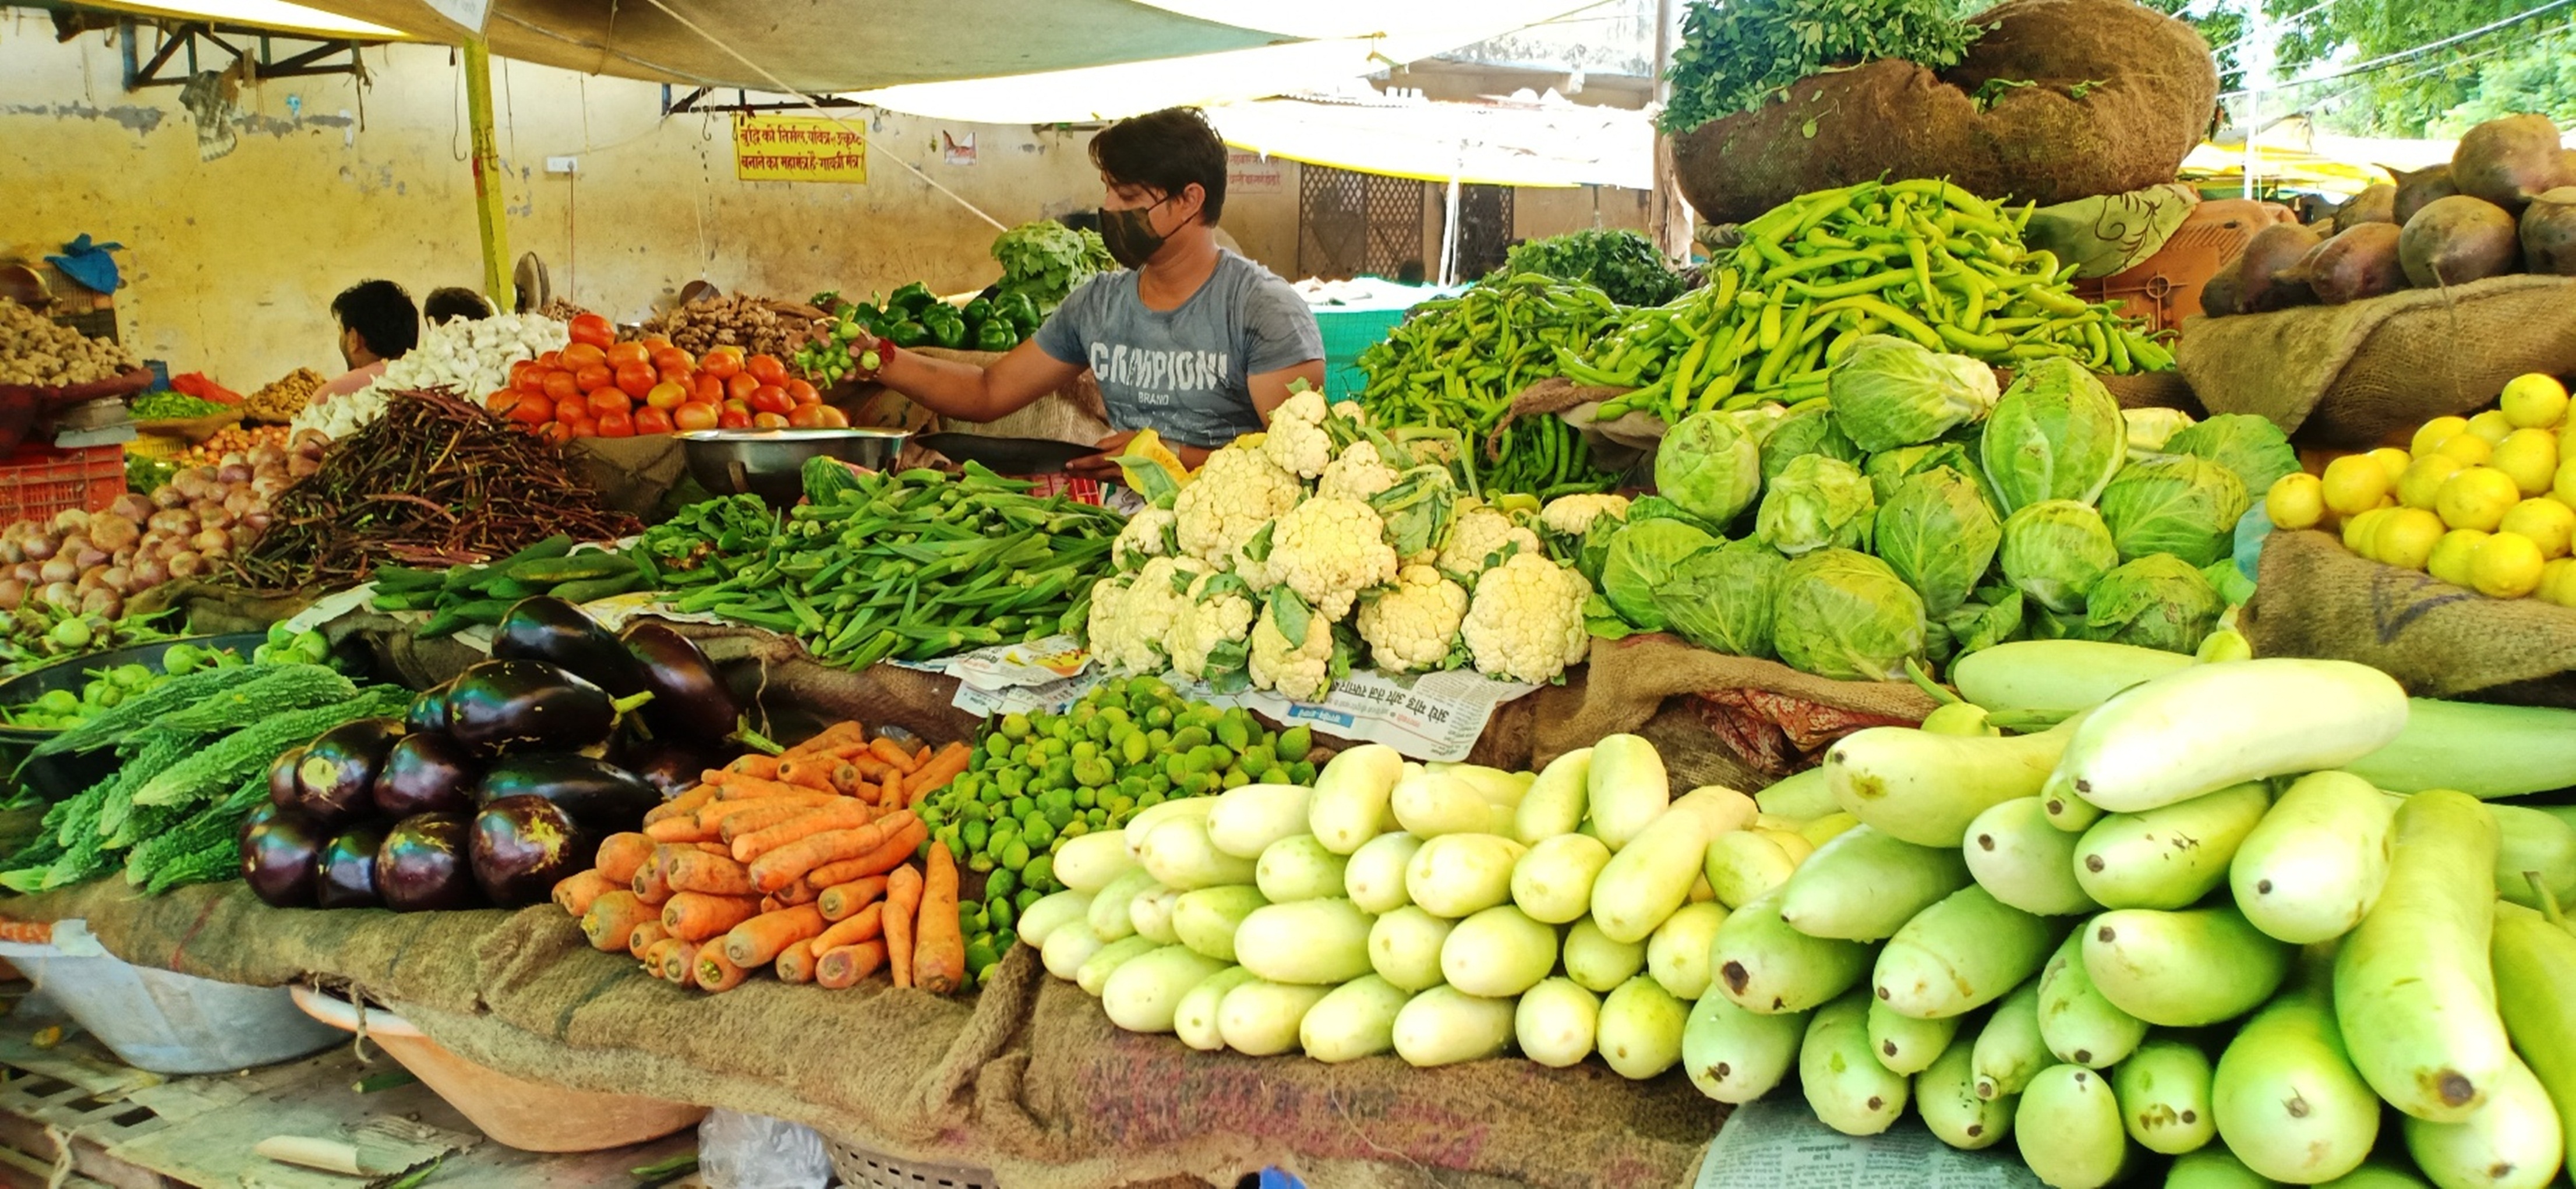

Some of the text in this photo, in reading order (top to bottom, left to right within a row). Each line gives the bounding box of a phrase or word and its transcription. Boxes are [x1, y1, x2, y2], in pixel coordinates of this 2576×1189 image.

[762, 124, 775, 143] को
[741, 150, 765, 170] बनाने
[766, 155, 779, 170] का
[1138, 392, 1169, 405] BRAND
[1367, 686, 1386, 703] तेज
[1386, 691, 1406, 706] और
